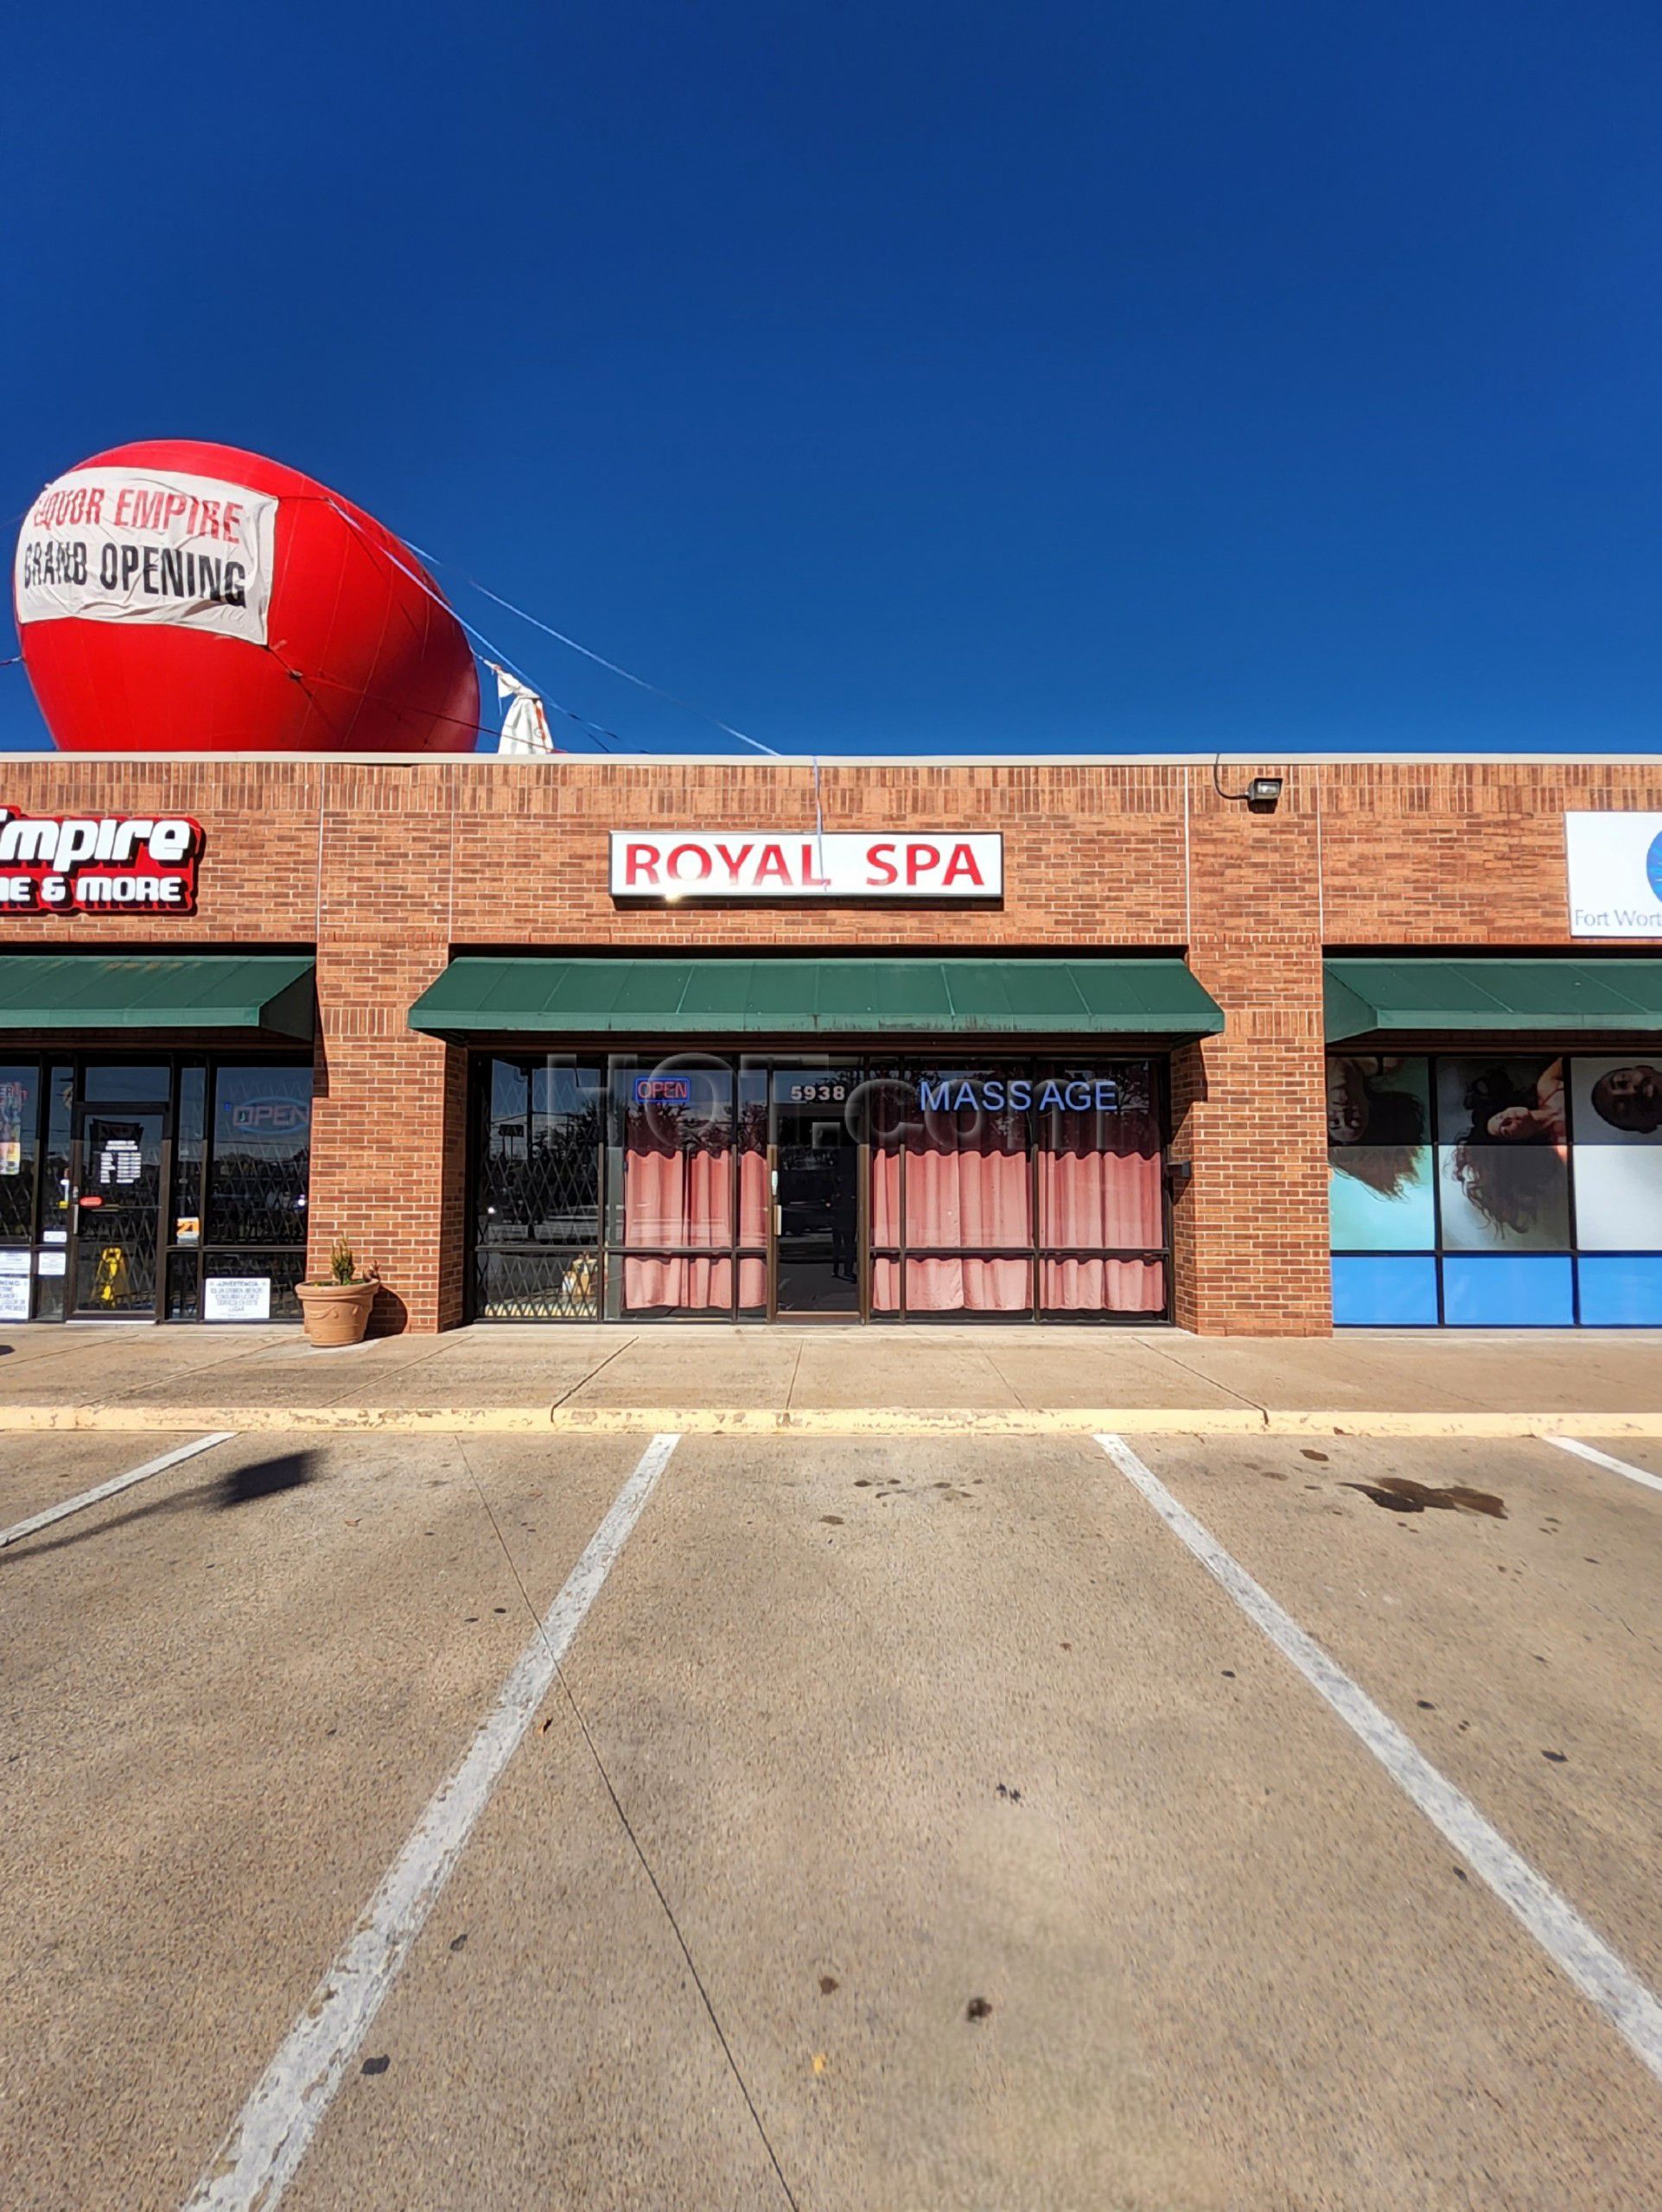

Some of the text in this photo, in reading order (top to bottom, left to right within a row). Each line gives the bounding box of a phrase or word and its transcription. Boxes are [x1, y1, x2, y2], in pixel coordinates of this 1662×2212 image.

[114, 488, 244, 543] EMPIRE
[24, 540, 246, 608] GRAND OPENING
[0, 810, 190, 873] mpire
[625, 842, 985, 887] ROYAL SPA
[41, 876, 66, 901] &
[75, 876, 181, 901] MORE
[1575, 909, 1610, 926] Fort
[636, 1079, 689, 1099] OPEN
[790, 1084, 846, 1102] 5938
[919, 1080, 1118, 1112] MASSAGE
[233, 1104, 309, 1127] OPEN
